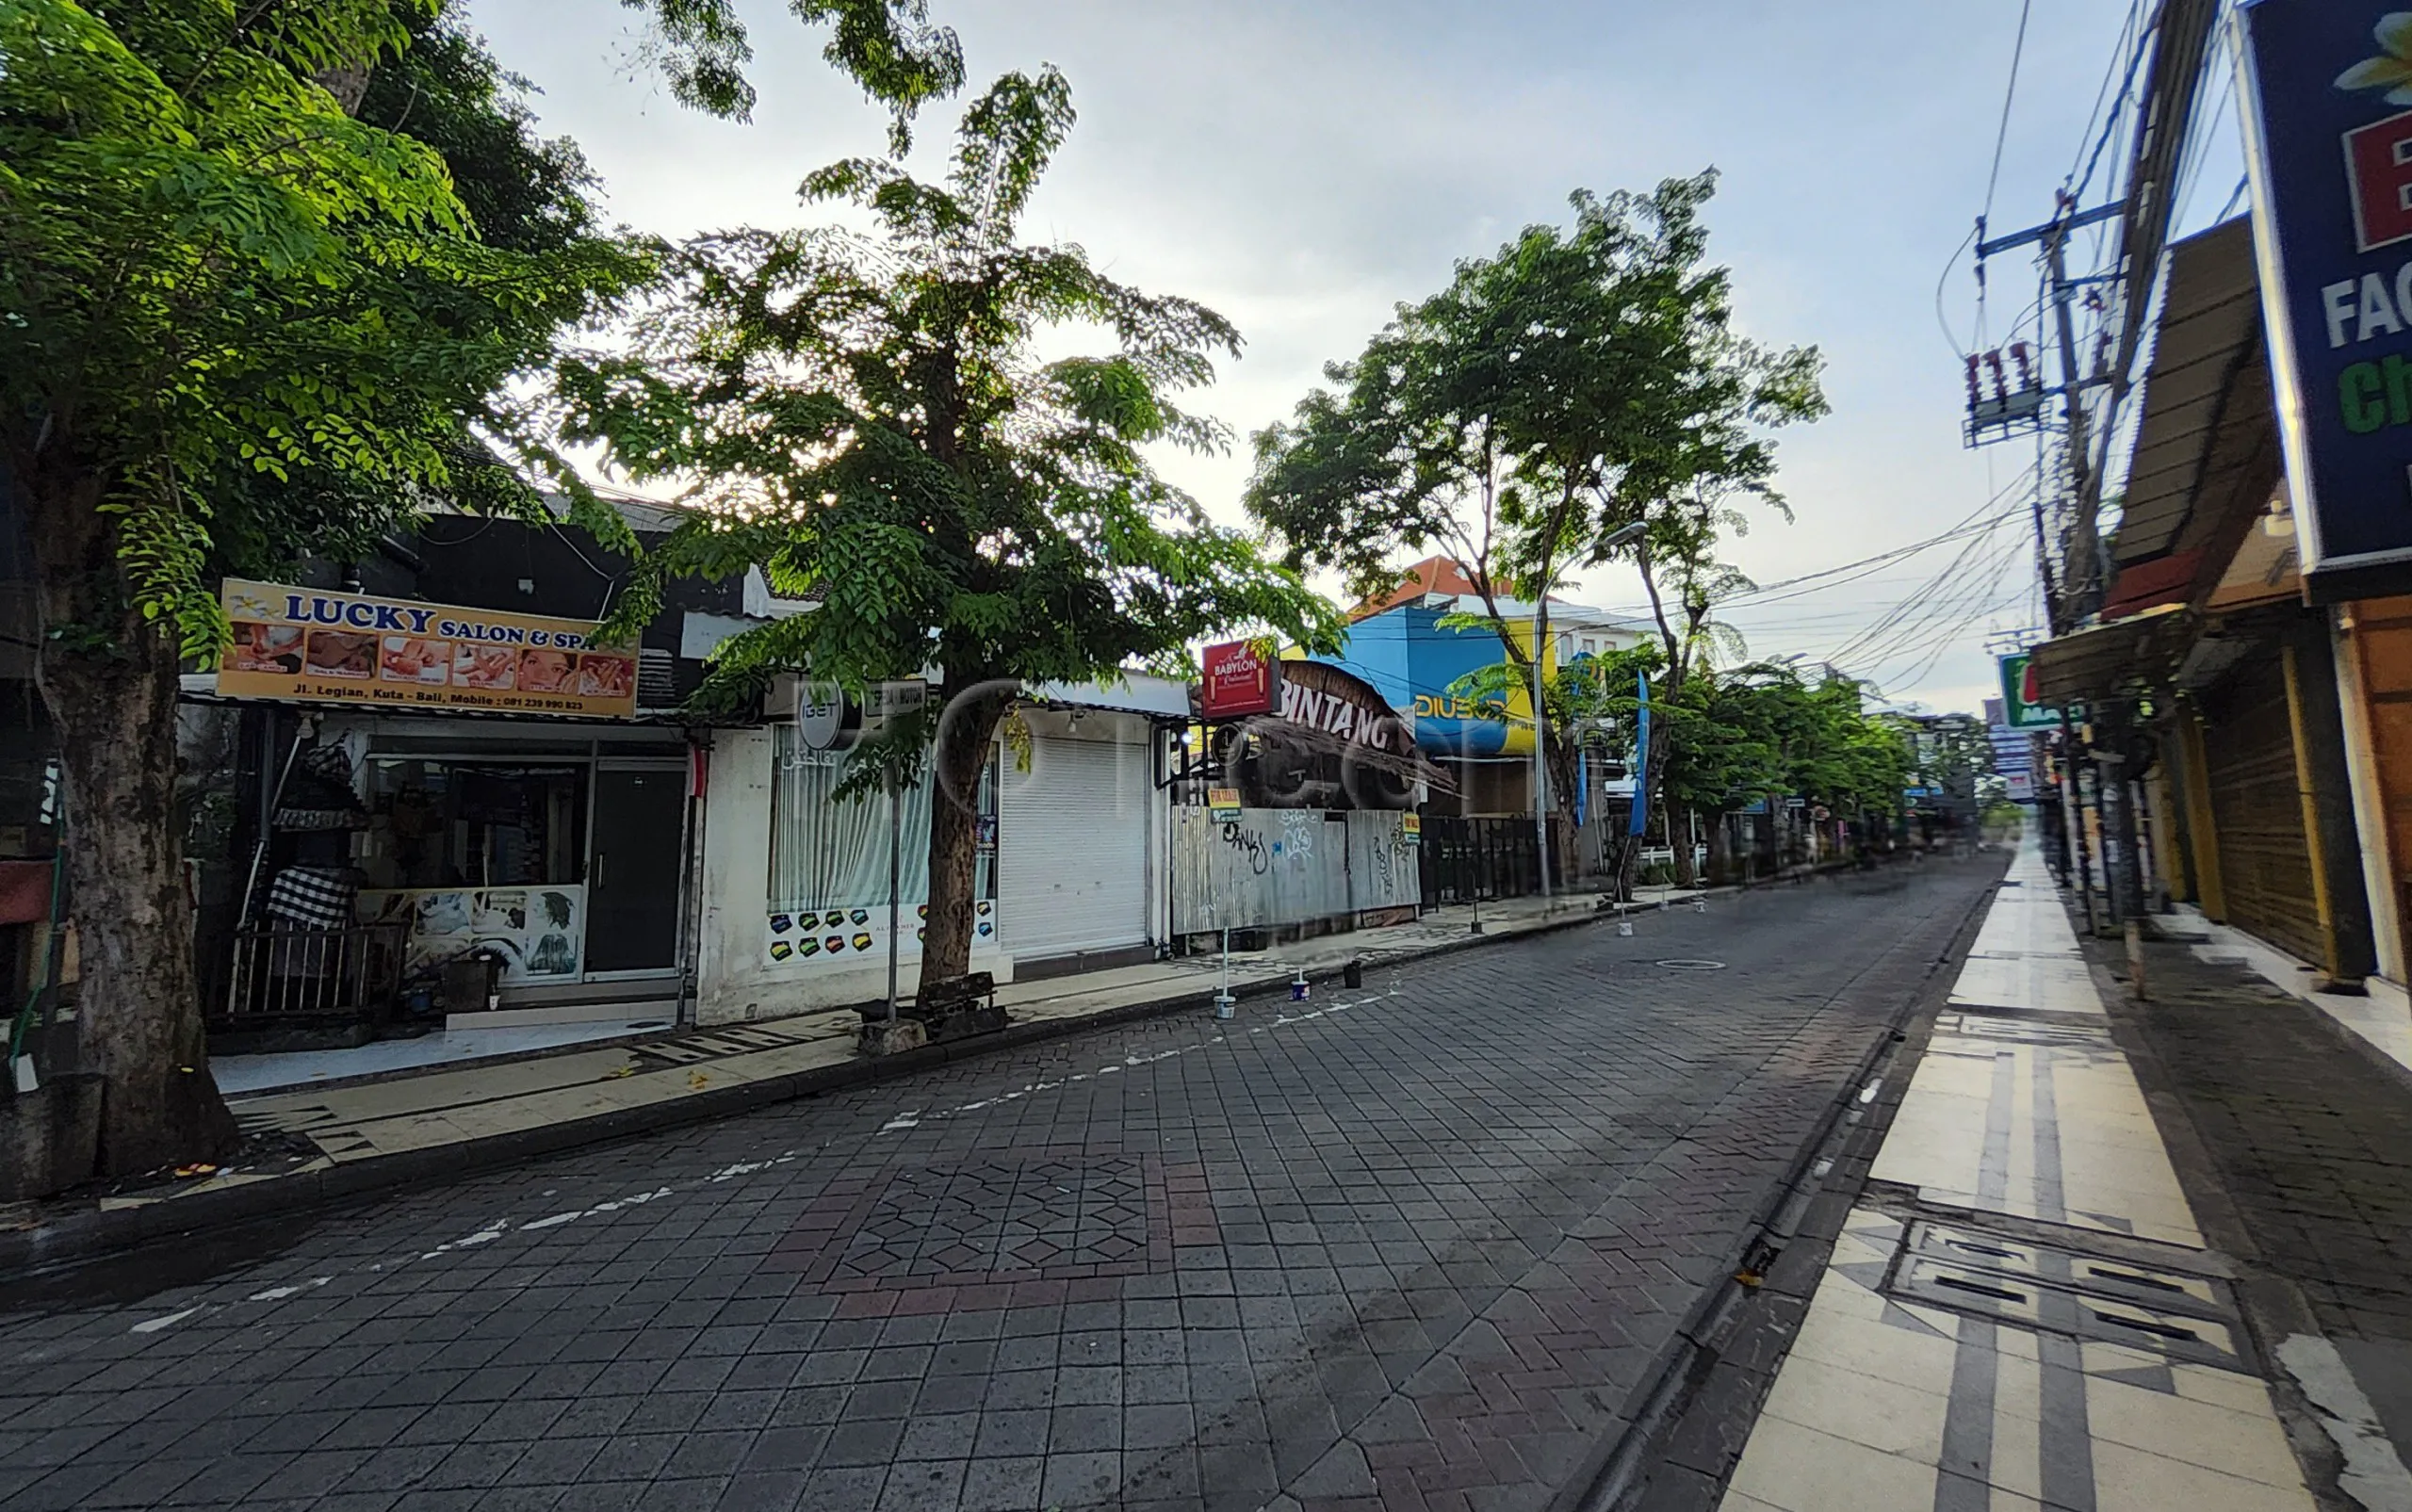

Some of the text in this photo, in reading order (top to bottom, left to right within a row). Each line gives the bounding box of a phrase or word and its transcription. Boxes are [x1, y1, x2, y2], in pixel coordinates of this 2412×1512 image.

[284, 594, 596, 651] LUCKY SALON & SPA
[1214, 659, 1257, 676] BABYLON
[317, 686, 368, 699] Legian,
[373, 689, 403, 700] Kuta
[416, 692, 446, 704] Bali,
[450, 694, 493, 706] Mobile
[503, 697, 522, 706] 081
[1270, 678, 1388, 749] BINTANG
